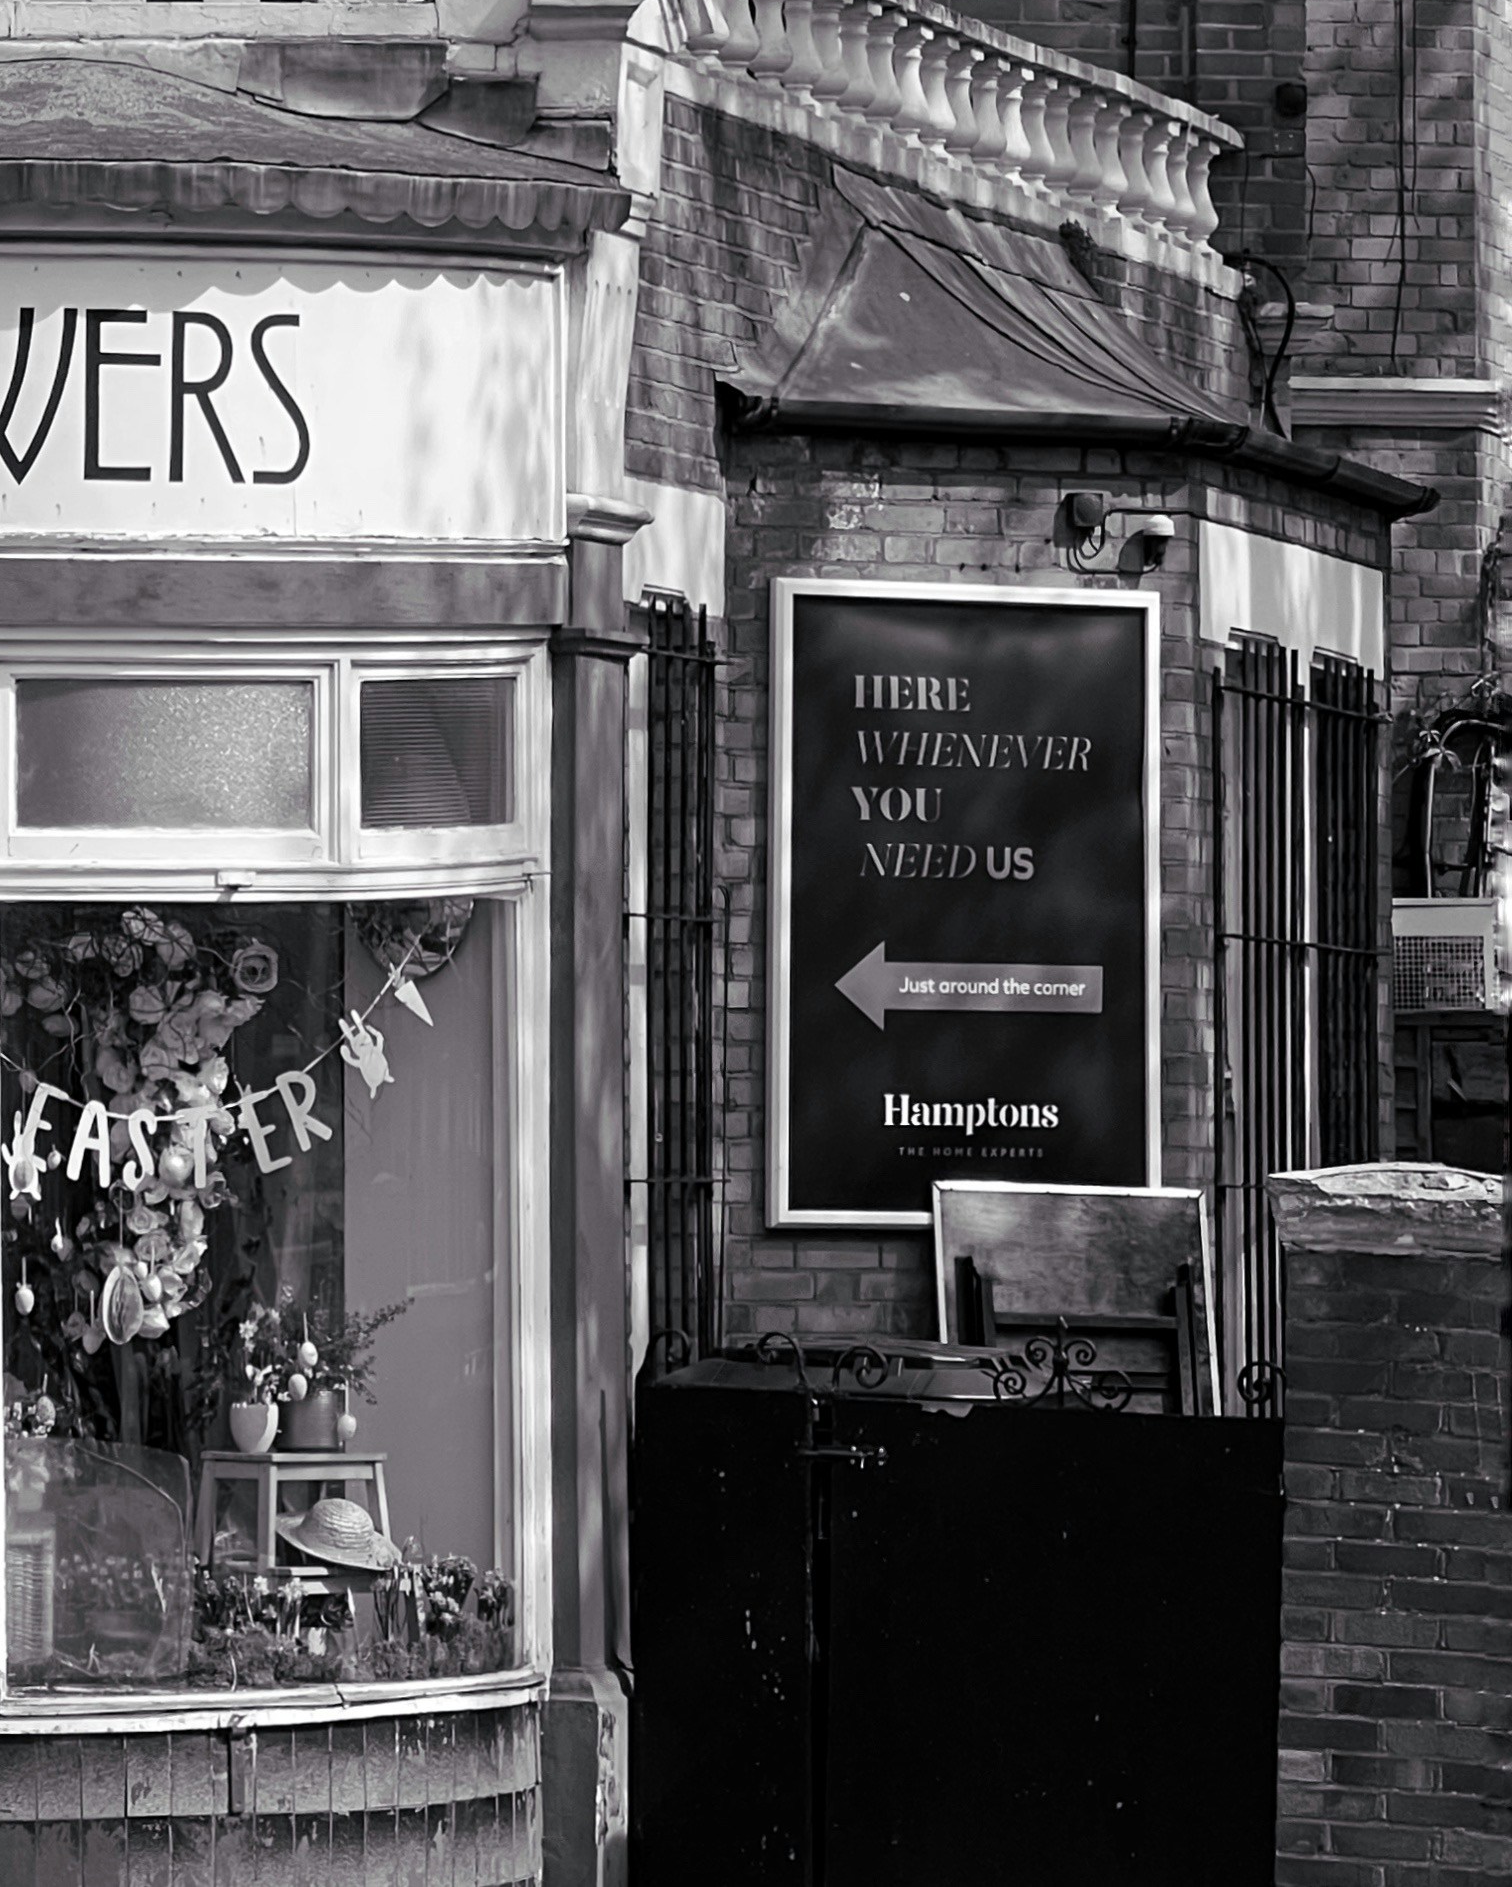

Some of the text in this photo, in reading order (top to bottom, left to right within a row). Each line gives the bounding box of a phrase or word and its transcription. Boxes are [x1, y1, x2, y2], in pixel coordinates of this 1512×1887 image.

[854, 674, 971, 712] HERE
[857, 730, 1093, 772] WHENEVER
[850, 786, 943, 823] YOU
[860, 842, 1035, 881] NEED US
[898, 976, 1087, 997] Just around the corner
[21, 1069, 333, 1191] EASTER
[883, 1093, 1059, 1136] Hamptons
